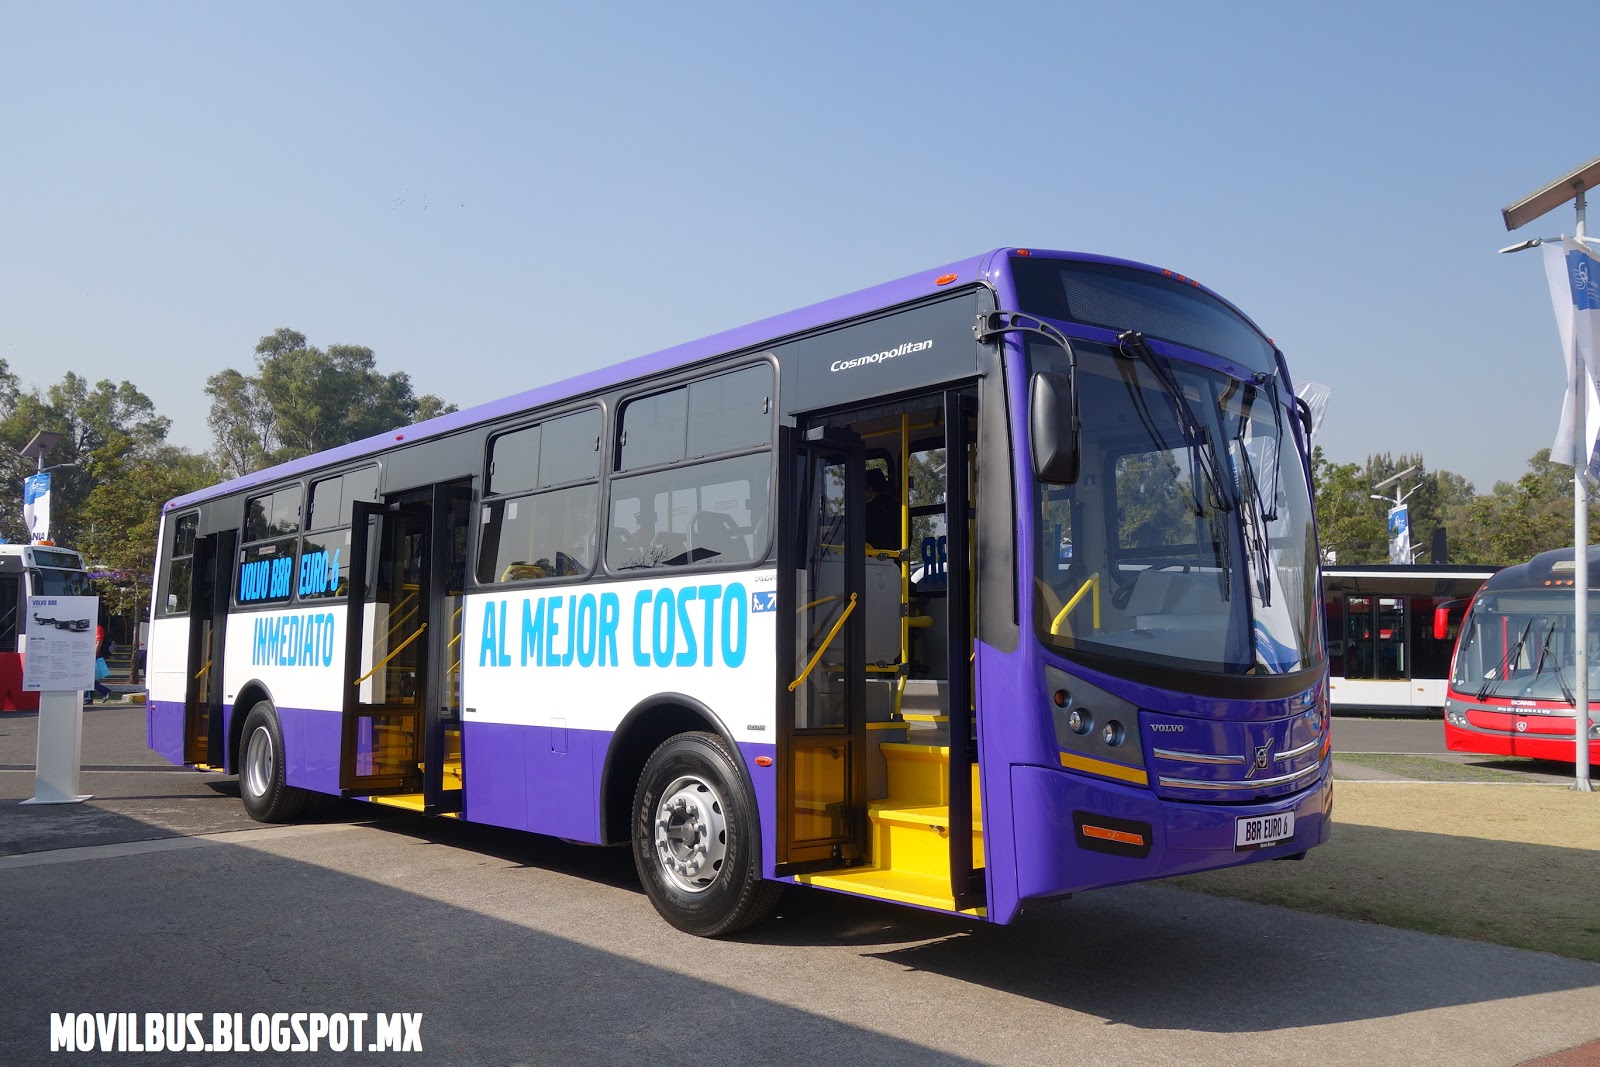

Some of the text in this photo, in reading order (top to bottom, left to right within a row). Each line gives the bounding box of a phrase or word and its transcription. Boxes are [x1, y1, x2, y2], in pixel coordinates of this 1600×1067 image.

[830, 339, 933, 372] Cosmopolitan
[240, 548, 340, 601] VOLVO B8R EURO 6
[252, 613, 335, 667] INMEDIATO
[479, 582, 747, 668] AL MEJOR COSTO
[1151, 724, 1184, 732] VOLVO
[639, 790, 653, 859] M788
[1245, 815, 1288, 842] B8R EURO 6
